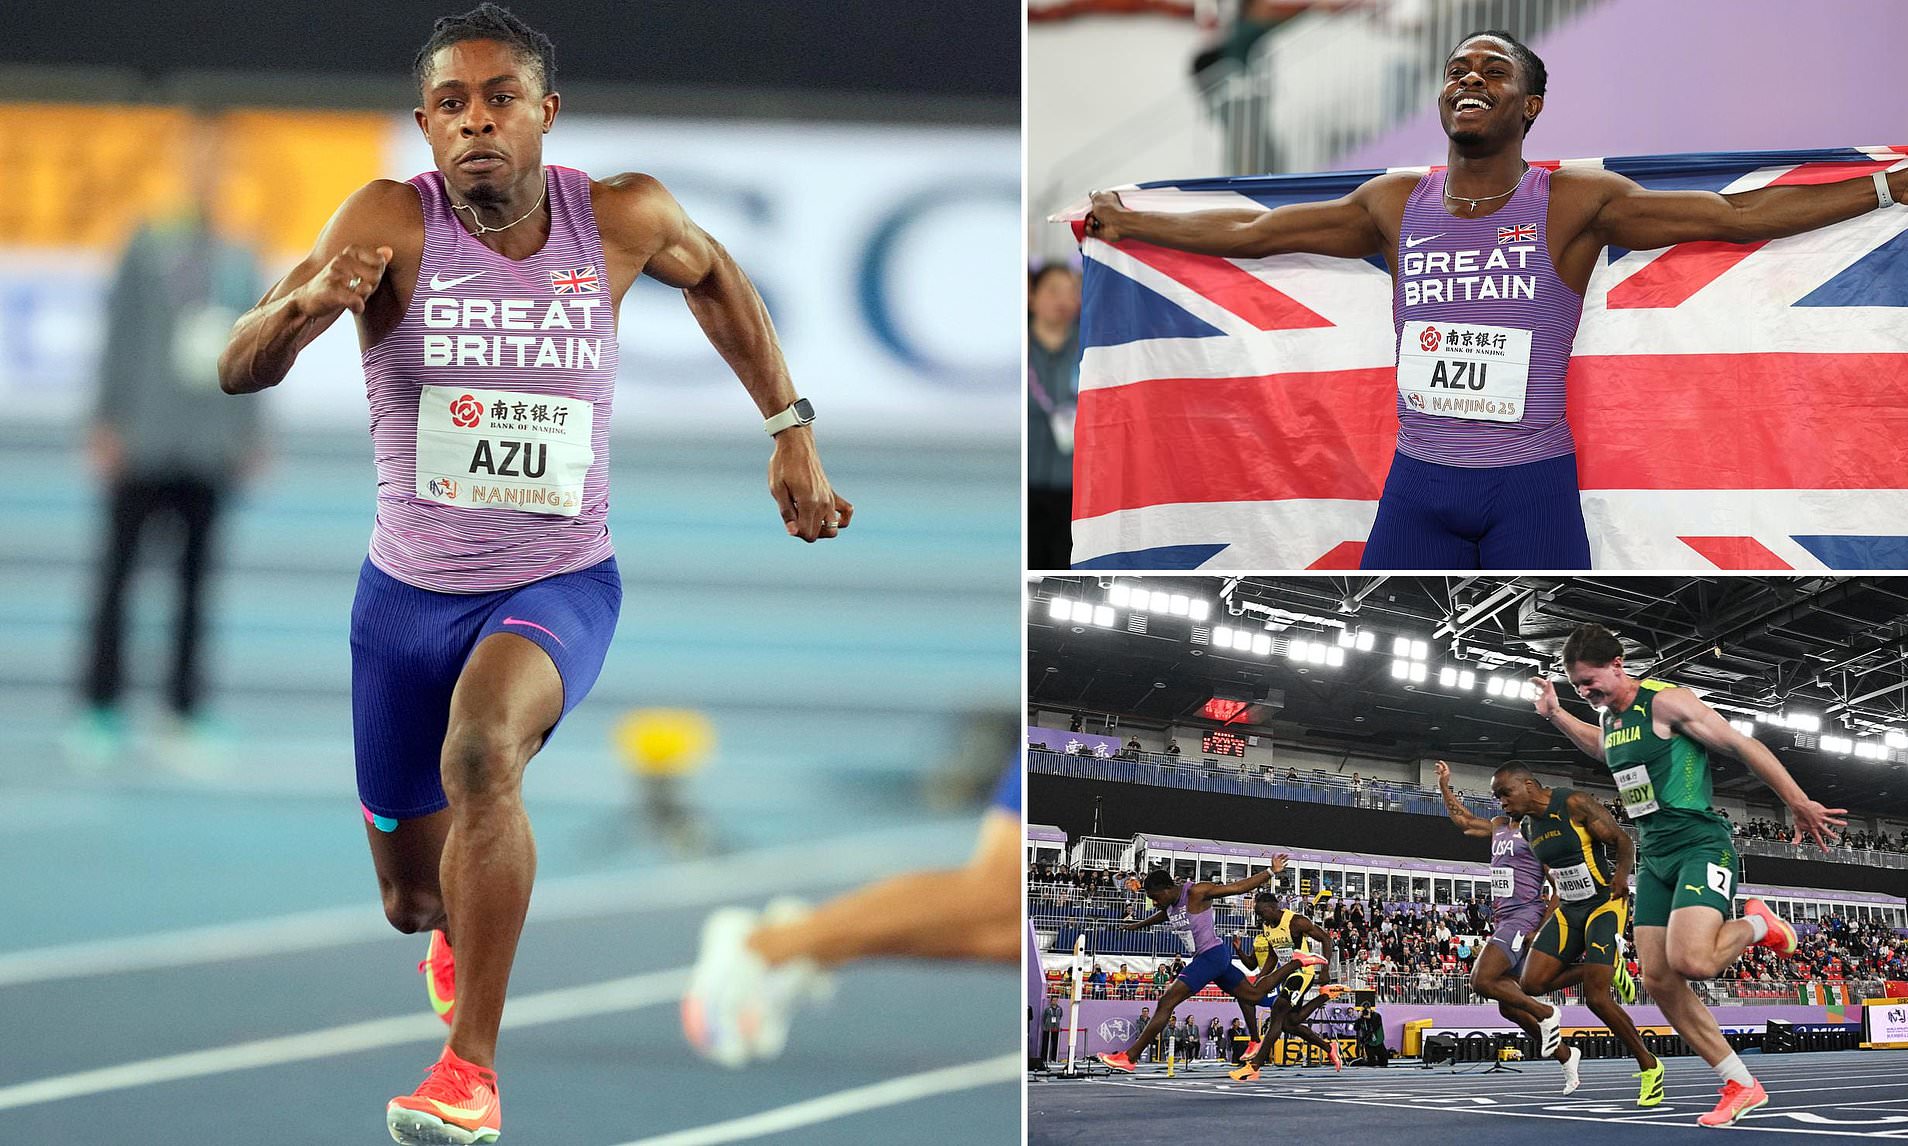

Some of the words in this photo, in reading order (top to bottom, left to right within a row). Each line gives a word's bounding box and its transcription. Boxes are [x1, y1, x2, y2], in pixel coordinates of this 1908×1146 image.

[1404, 246, 1536, 276] GREAT
[1404, 275, 1536, 306] BRITAIN
[424, 298, 601, 330] GREAT
[424, 335, 601, 369] BRITAIN
[1446, 329, 1507, 349] 南京银行
[1430, 360, 1487, 391] AZU
[490, 400, 568, 426] 南京银行
[1432, 397, 1496, 414] NANJING
[1498, 402, 1516, 415] 25
[490, 422, 514, 430] BANK
[532, 425, 566, 435] NANJING
[468, 439, 548, 478] AZU
[472, 485, 560, 507] NANJING
[1492, 840, 1514, 856] USA
[1717, 871, 1726, 890] 2
